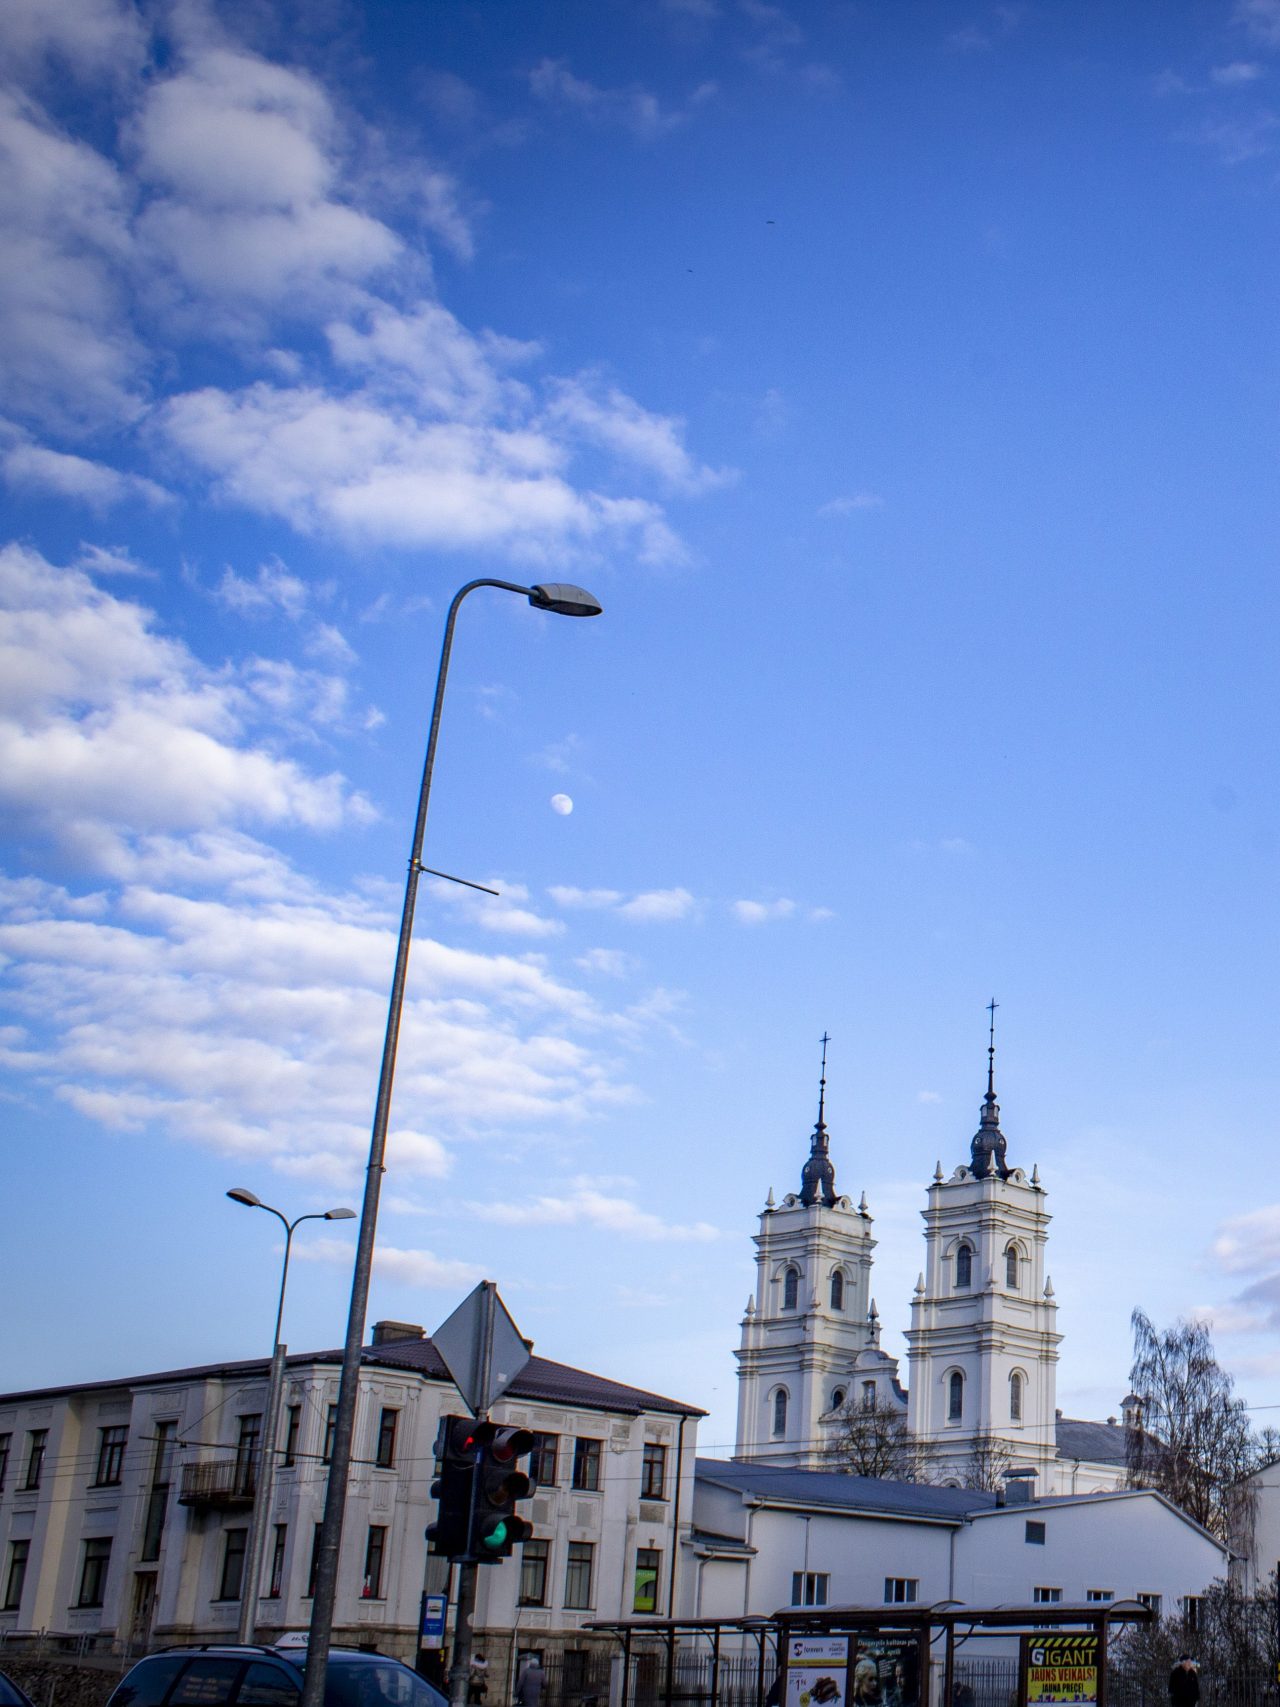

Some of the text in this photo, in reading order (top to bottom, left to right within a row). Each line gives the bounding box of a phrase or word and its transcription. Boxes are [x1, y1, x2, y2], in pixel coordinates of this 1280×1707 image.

[1031, 1648, 1096, 1666] GIGANT
[1031, 1667, 1095, 1682] JAUNS VEIKALS!
[1042, 1683, 1084, 1693] JAUNA PRECE!
